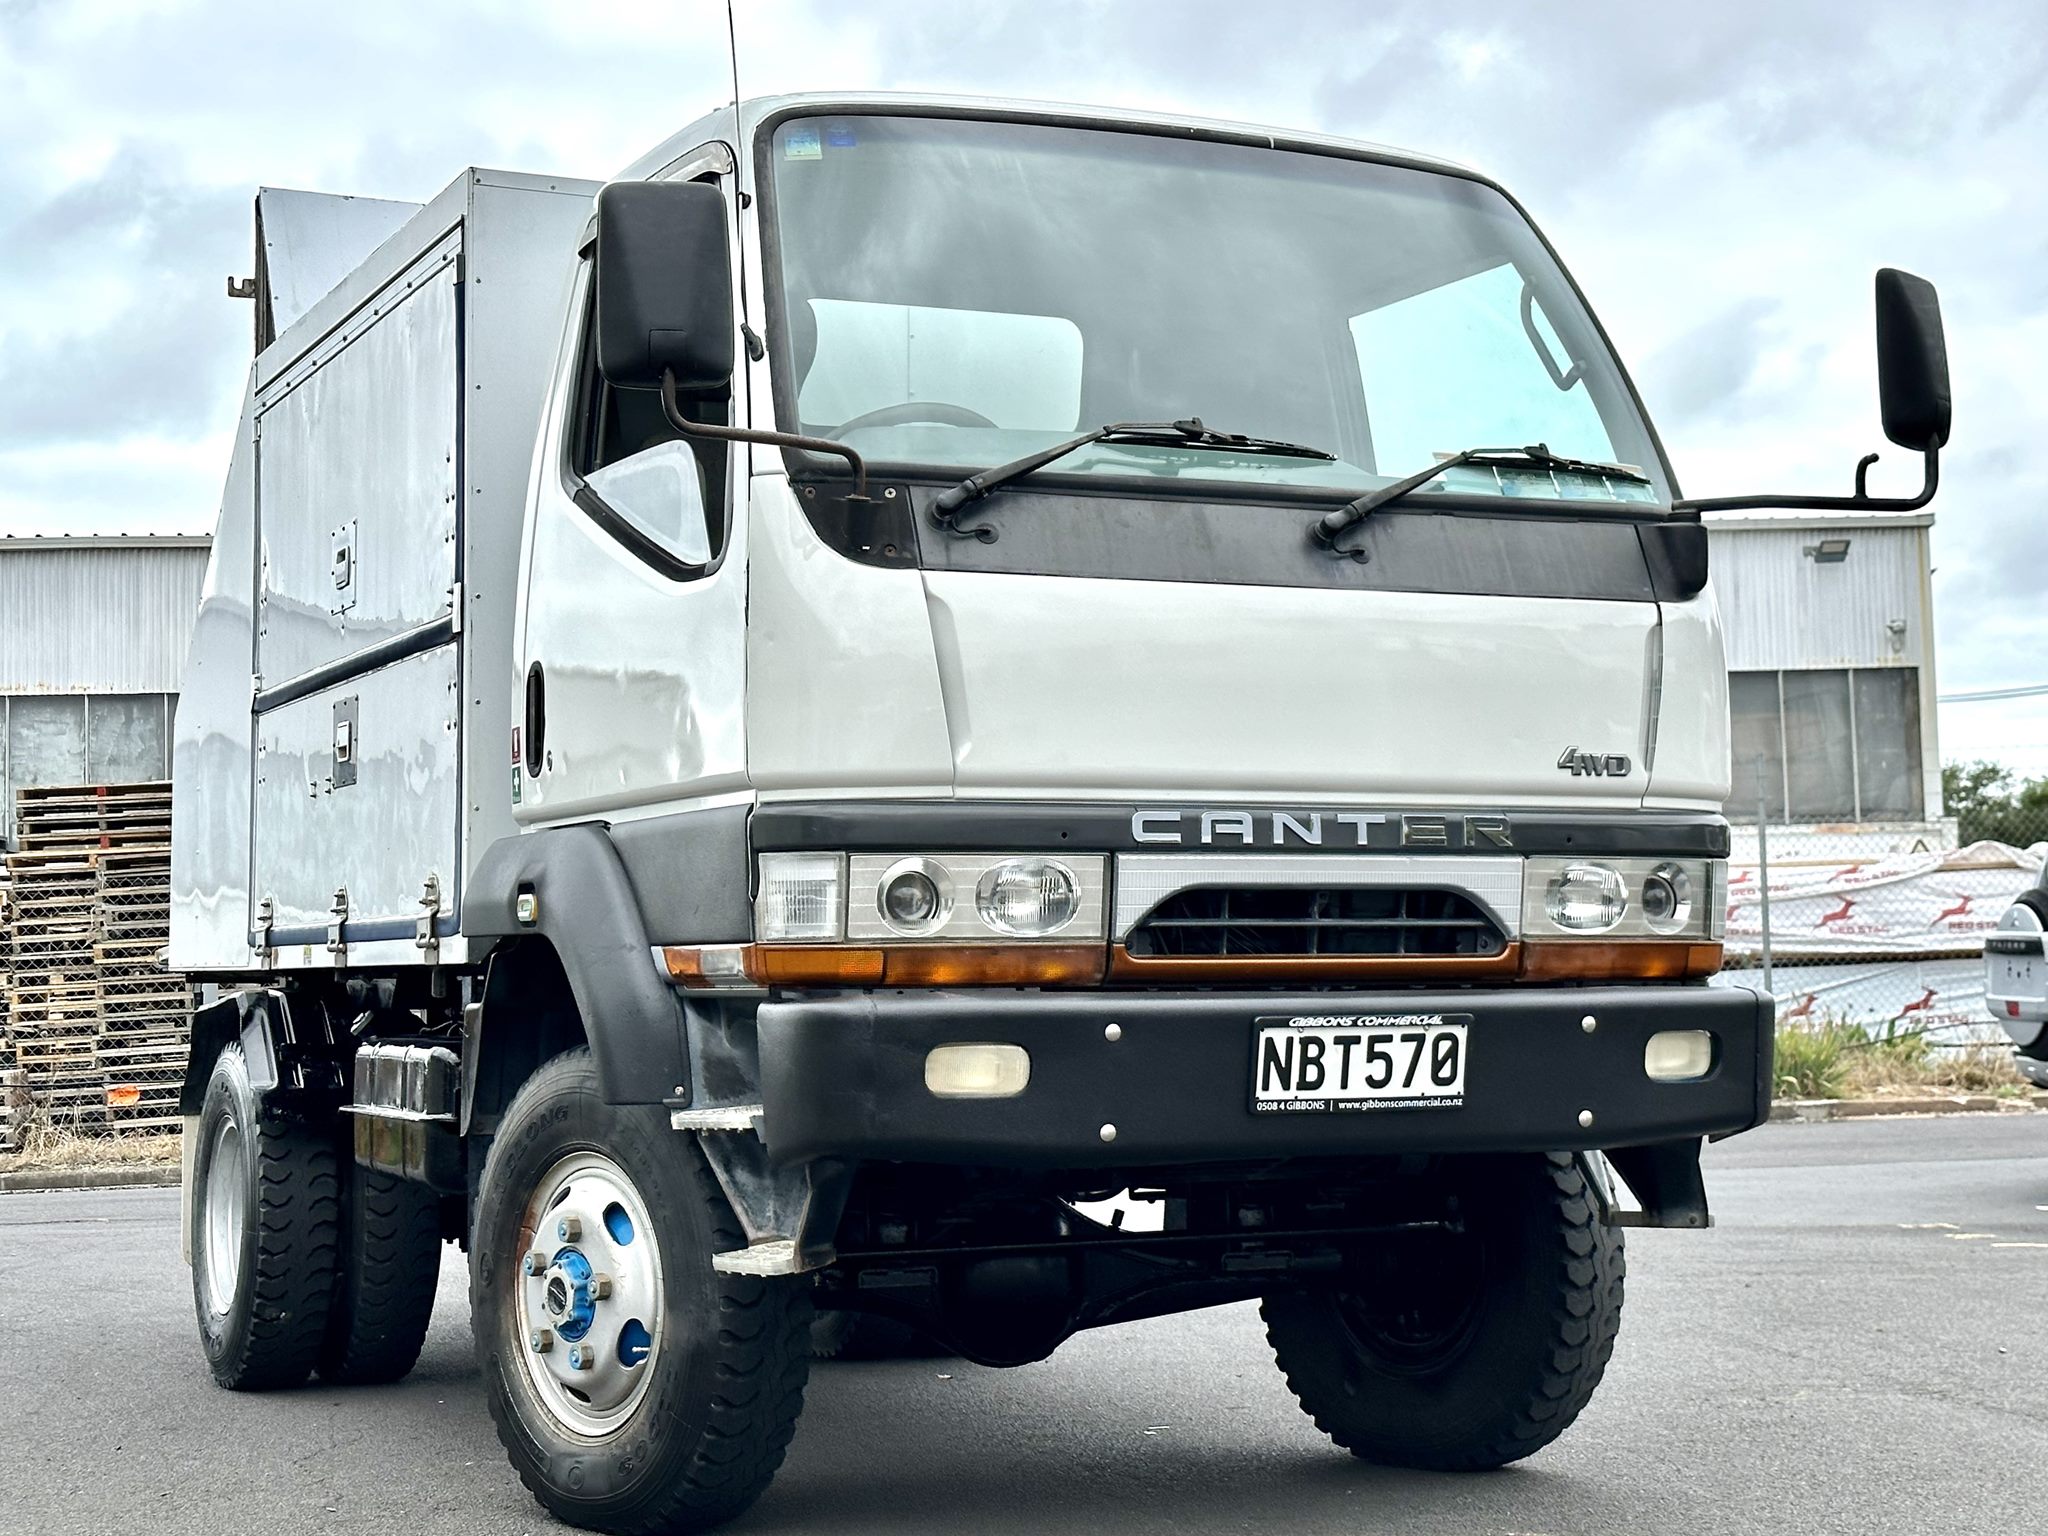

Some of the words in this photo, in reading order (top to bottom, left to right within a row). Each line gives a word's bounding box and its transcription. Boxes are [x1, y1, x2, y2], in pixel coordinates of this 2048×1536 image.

[1557, 745, 1632, 776] 4WD
[1131, 810, 1513, 847] CANTER
[1948, 921, 1974, 930] RED
[1976, 920, 1999, 929] STA
[1288, 1015, 1357, 1027] GIBBONS
[1356, 1014, 1444, 1026] COMMERCIAL
[1261, 1031, 1460, 1092] NBT570
[1256, 1101, 1279, 1111] 0508
[1279, 1101, 1285, 1110] 4
[1286, 1100, 1325, 1110] GIBBONS
[1338, 1097, 1463, 1110] www.gibbonscommercial.co.nz
